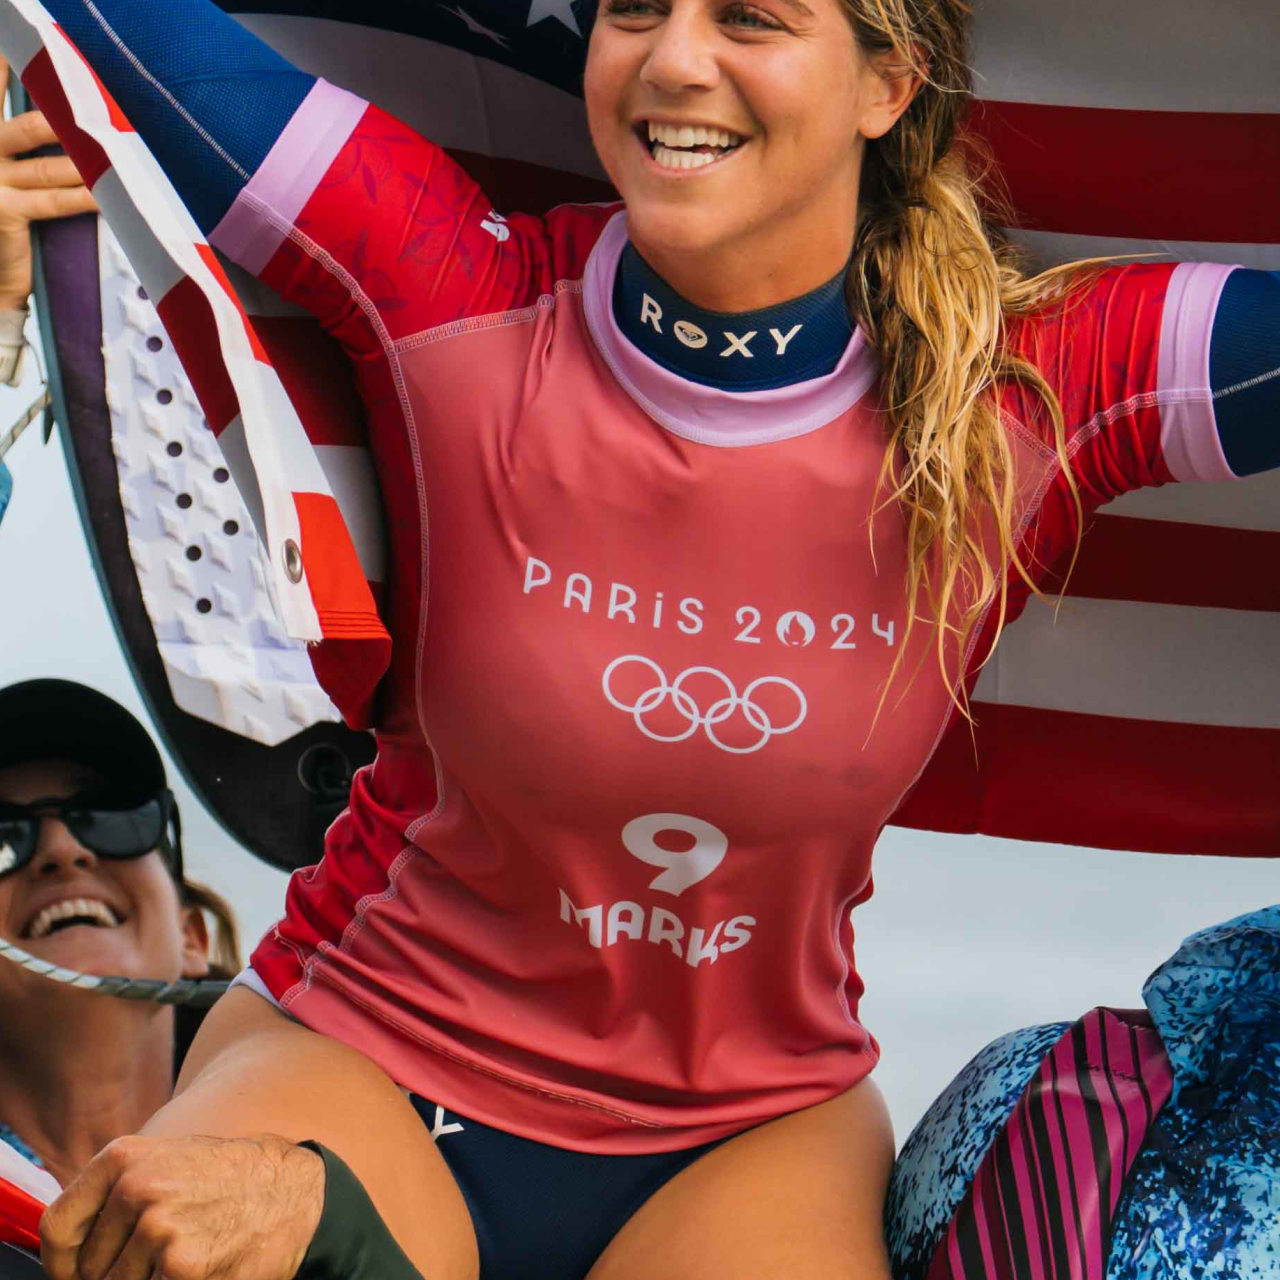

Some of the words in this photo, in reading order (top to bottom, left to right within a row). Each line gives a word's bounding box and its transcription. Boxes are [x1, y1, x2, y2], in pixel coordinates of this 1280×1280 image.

[640, 293, 804, 358] ROXY
[734, 605, 896, 649] 2024
[621, 813, 729, 897] 9
[559, 887, 757, 968] MARKS
